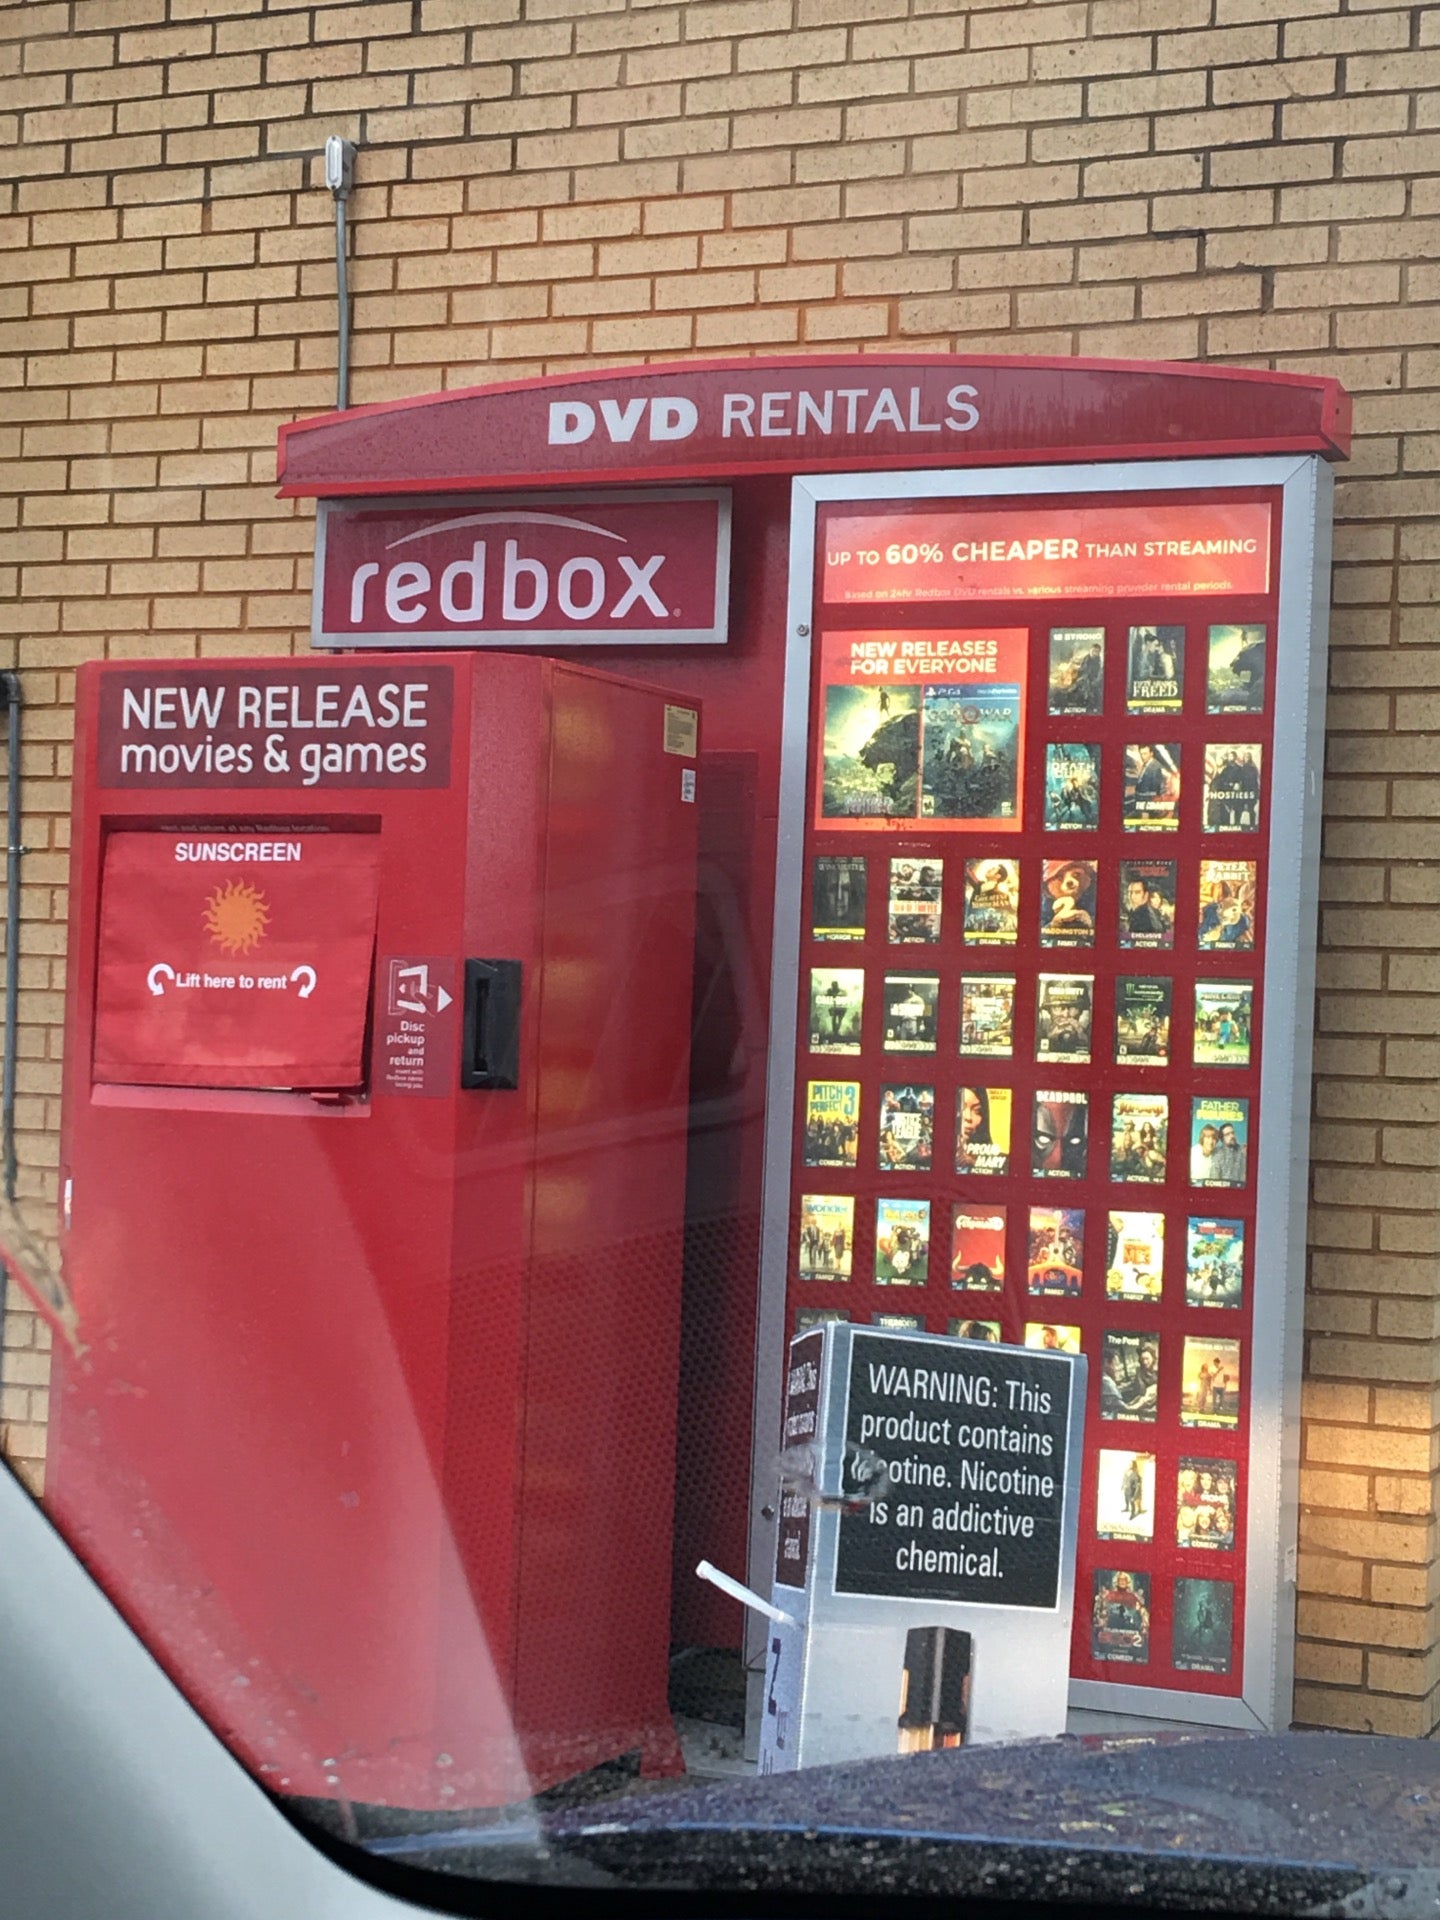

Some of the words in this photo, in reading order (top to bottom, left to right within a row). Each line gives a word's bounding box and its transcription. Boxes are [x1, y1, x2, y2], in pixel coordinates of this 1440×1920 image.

[547, 398, 698, 445] DVD
[722, 384, 980, 438] RENTALS
[827, 551, 851, 566] UP
[856, 551, 880, 566] TO
[885, 543, 944, 565] 60%
[951, 538, 1079, 563] CHEAPER
[1085, 543, 1137, 558] THAN
[1143, 538, 1258, 557] STREAMING
[350, 538, 670, 624] redbox
[875, 591, 888, 599] on
[1064, 584, 1114, 595] streaming
[1161, 582, 1191, 591] rental
[850, 642, 897, 658] NEW
[900, 640, 998, 657] RELEASES
[850, 659, 889, 675] FOR
[893, 658, 997, 674] EVERYONE
[1132, 685, 1179, 698] FREED
[122, 686, 225, 730] NEW
[237, 684, 429, 728] RELEASE
[120, 735, 254, 773] movies
[263, 735, 291, 774] &
[300, 741, 427, 785] games
[174, 842, 302, 862] SUNSCREEN
[1208, 861, 1248, 872] PETER
[1206, 870, 1250, 882] RABBIT
[176, 973, 201, 989] Lift
[203, 973, 235, 990] here
[238, 975, 254, 990] to
[257, 974, 287, 990] rent
[400, 1020, 425, 1032] Disc
[386, 1033, 425, 1045] pickup
[408, 1047, 424, 1056] and
[389, 1055, 424, 1066] return
[812, 1085, 843, 1100] PITCH
[843, 1085, 856, 1116] 3
[1036, 1090, 1088, 1104] DEADPOOL
[810, 1101, 843, 1113] PERFECT
[1201, 1100, 1240, 1112] FATHER
[966, 1143, 1001, 1156] PROUD
[974, 1156, 1006, 1168] MARY
[1107, 1335, 1122, 1345] The
[869, 1363, 998, 1409] WARNING:
[1005, 1379, 1052, 1414] This
[860, 1411, 951, 1446] product
[958, 1421, 1054, 1457] contains
[852, 1450, 951, 1489] otine.
[960, 1460, 1054, 1499] Nicotine
[896, 1504, 924, 1528] an
[932, 1501, 1035, 1538] addictive
[895, 1543, 1004, 1579] chemical.
